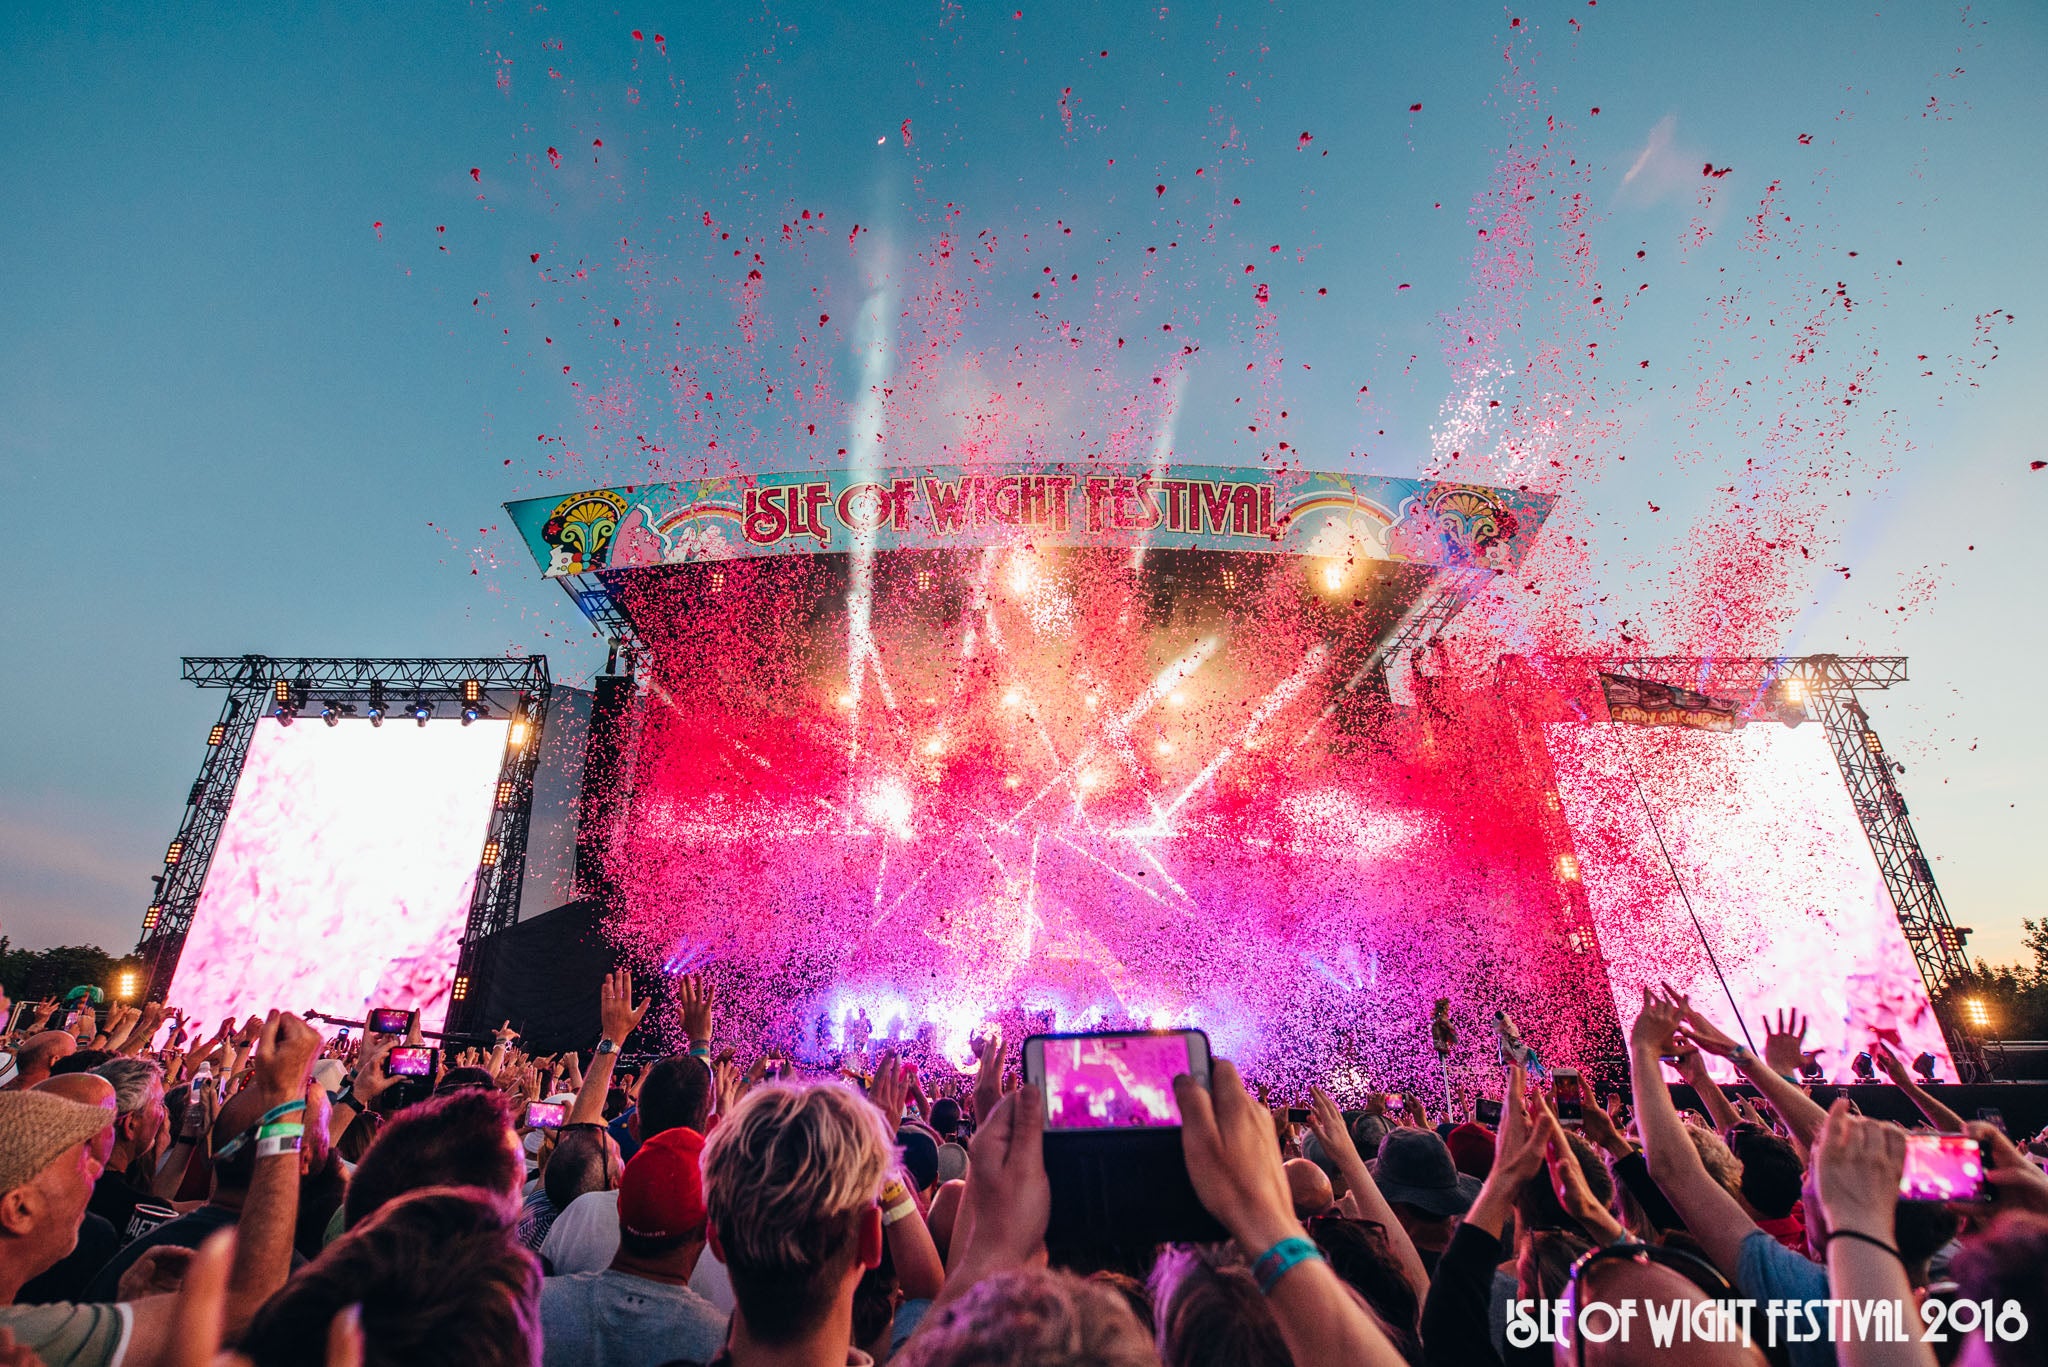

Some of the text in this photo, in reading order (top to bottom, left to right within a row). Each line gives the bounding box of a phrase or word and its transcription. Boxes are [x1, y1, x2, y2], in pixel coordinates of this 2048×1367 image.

[741, 474, 1284, 546] ISLE OF WIGHT FESTIVAL
[1611, 706, 1656, 725] CARRY
[1660, 709, 1679, 723] ON
